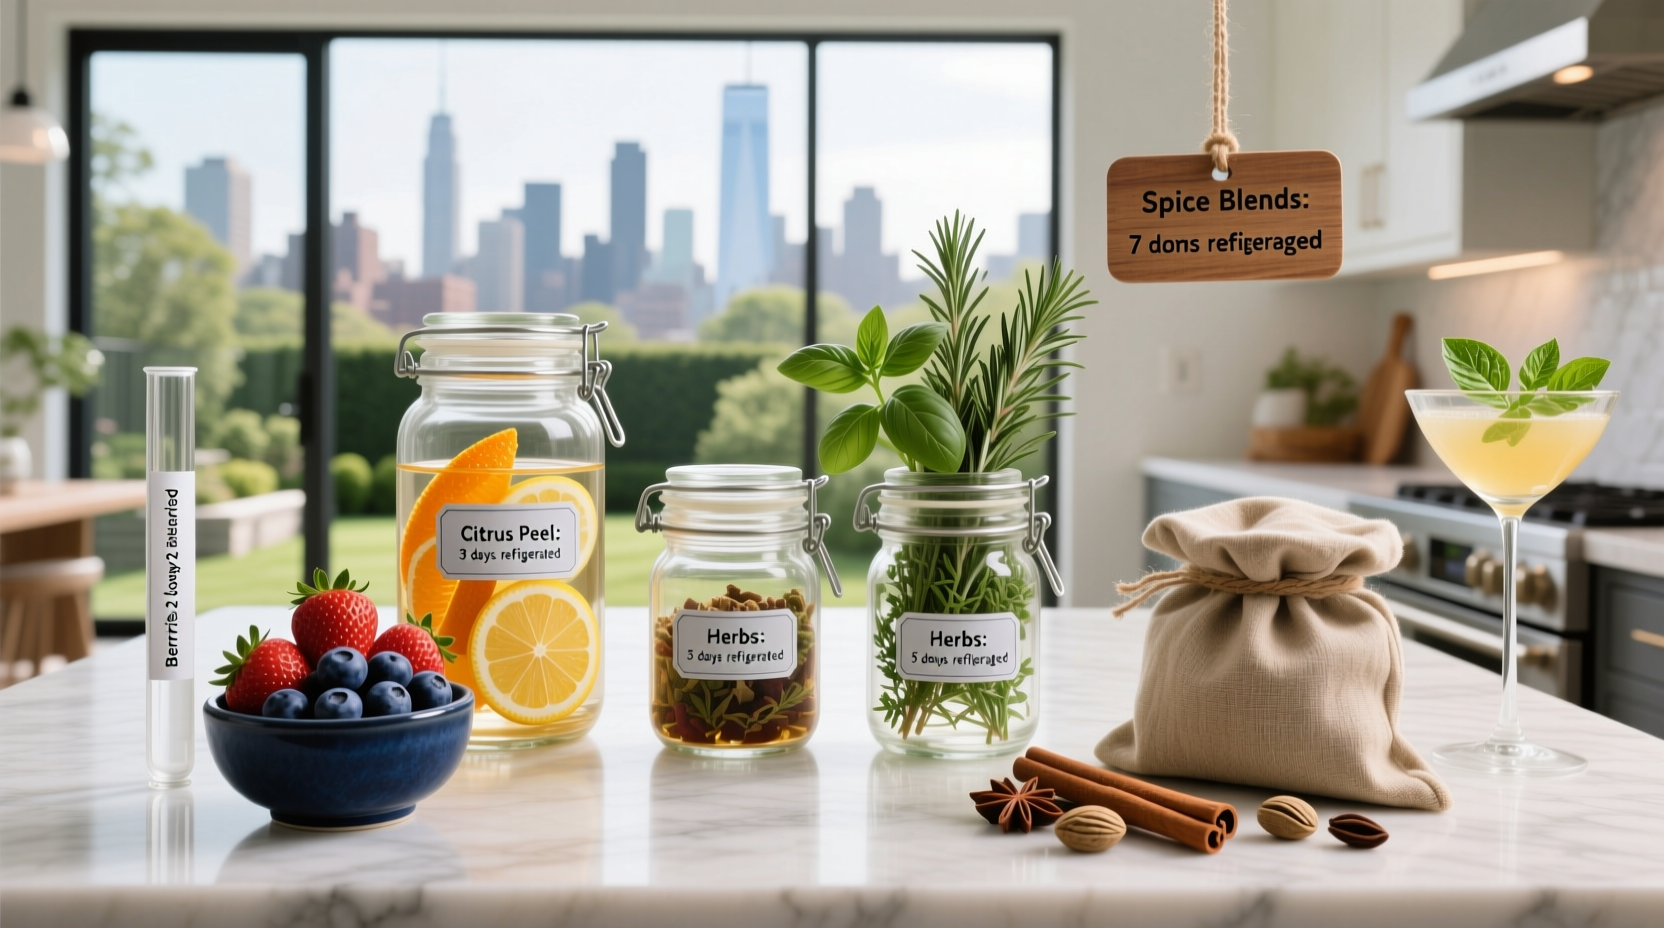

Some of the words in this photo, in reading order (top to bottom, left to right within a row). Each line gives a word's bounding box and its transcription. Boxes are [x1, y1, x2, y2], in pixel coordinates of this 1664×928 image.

[1142, 190, 1210, 218] Spice
[1219, 186, 1309, 211] Blends:
[1129, 234, 1142, 254] 7
[460, 525, 514, 542] Citrus
[519, 524, 561, 541] Peel:
[459, 548, 467, 560] 3
[470, 548, 496, 563] days
[707, 627, 765, 645] Herbs:
[930, 630, 987, 647] Herbs:
[911, 652, 918, 663] 5
